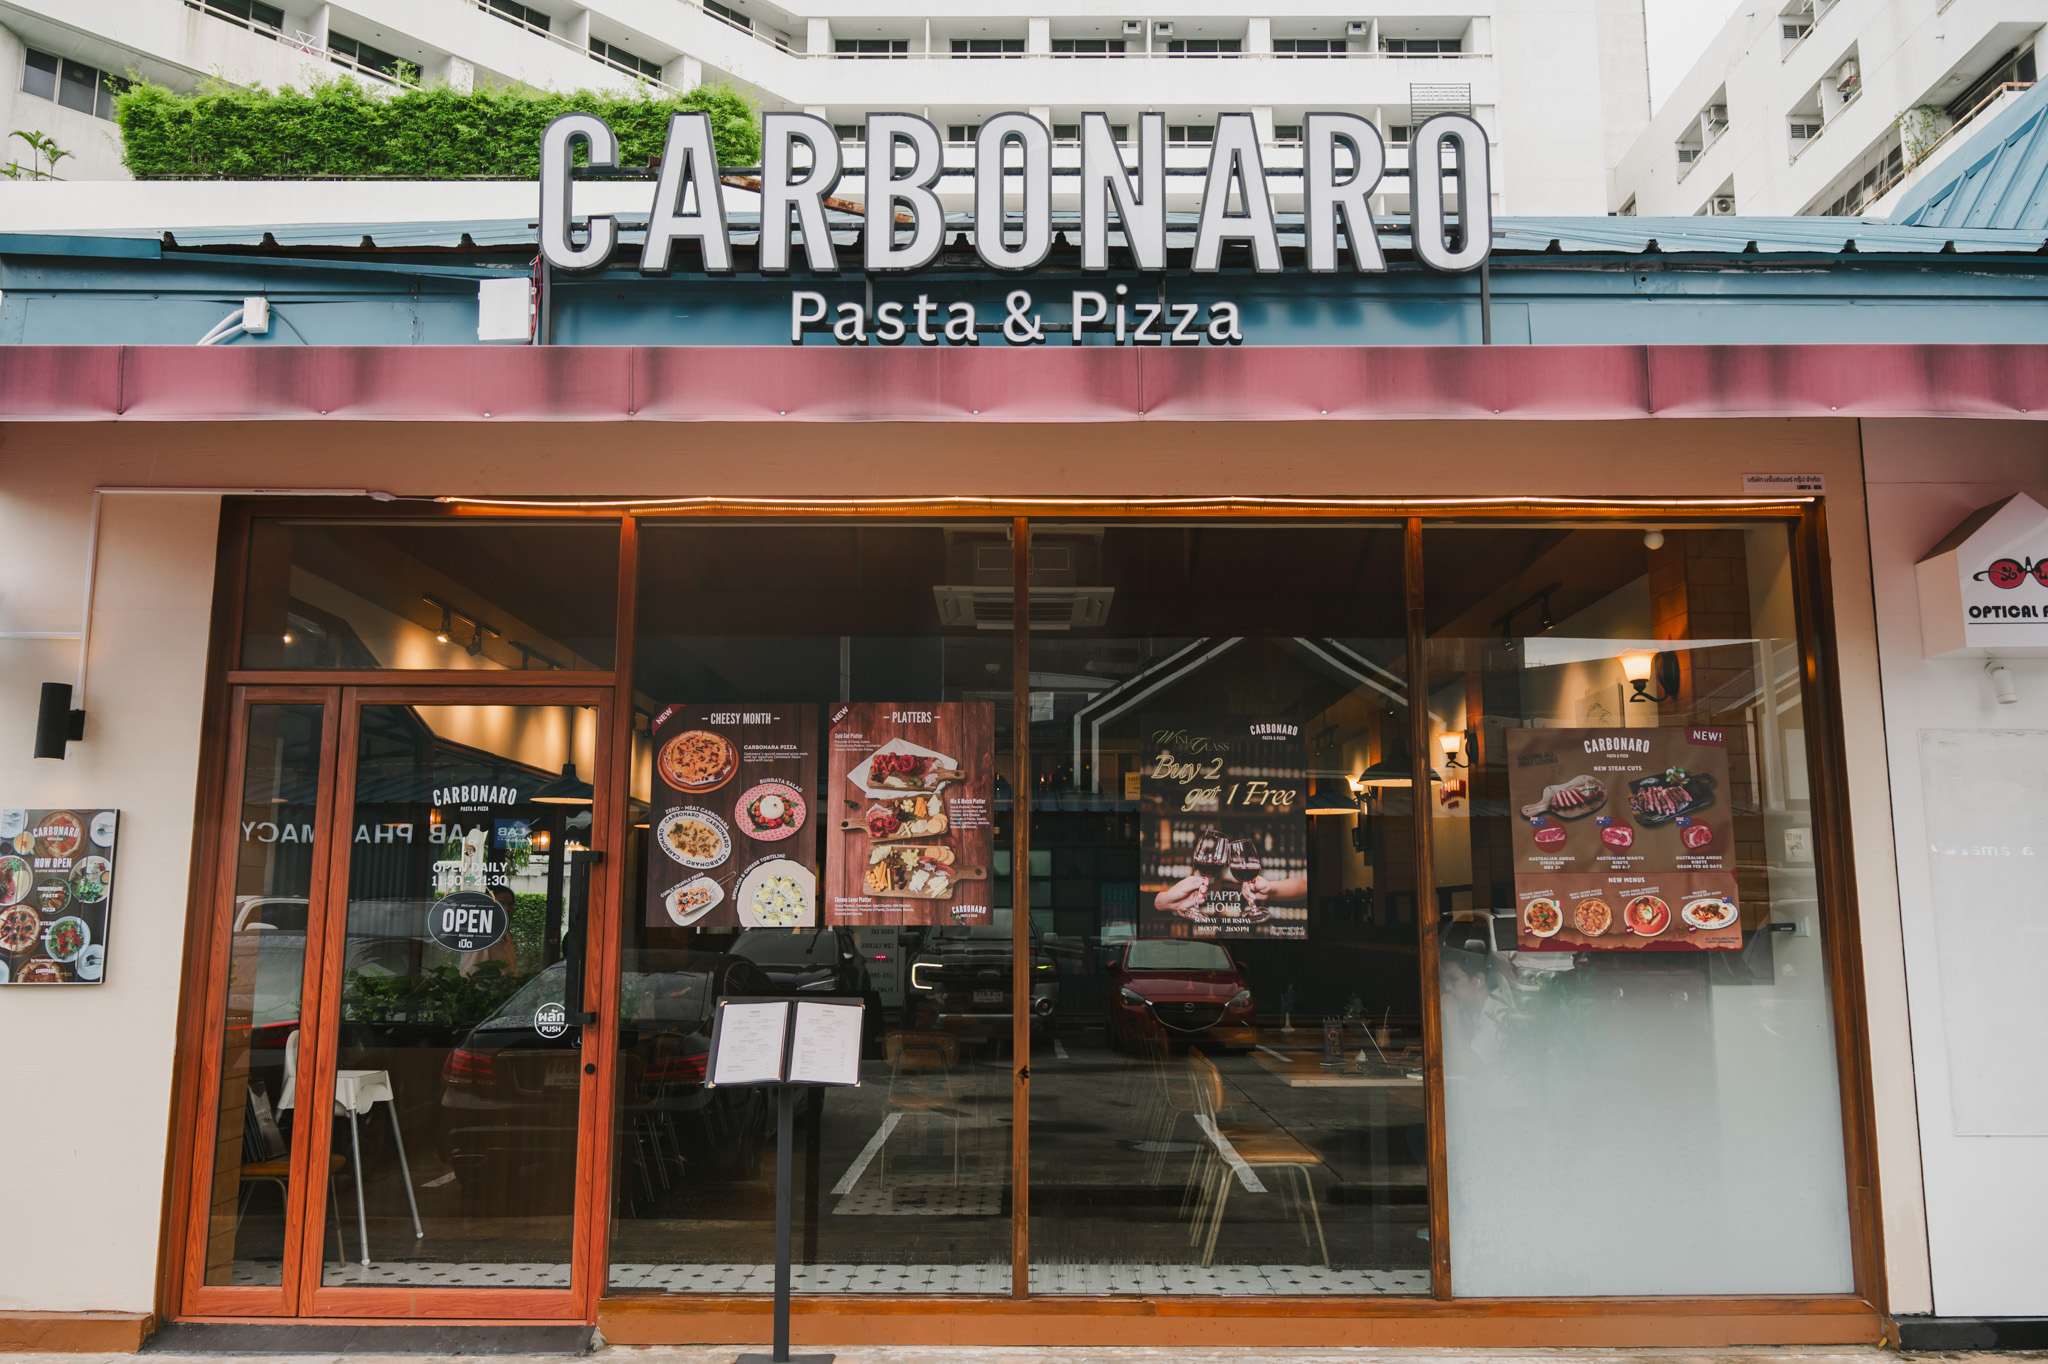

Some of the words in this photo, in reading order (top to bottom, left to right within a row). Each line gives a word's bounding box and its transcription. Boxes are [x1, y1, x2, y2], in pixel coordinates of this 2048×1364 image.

[538, 110, 1493, 276] CARBONARO
[791, 289, 979, 346] Pasta
[1000, 289, 1045, 346] &
[1071, 284, 1244, 346] Pizza
[1969, 605, 2038, 618] OPTICAL
[656, 708, 673, 725] NEW
[711, 713, 741, 724] CHEESY
[743, 713, 771, 724] MONTH
[832, 706, 849, 723] NEW
[892, 712, 932, 723] PLATTERS
[1250, 724, 1298, 736] CARBONARO
[1693, 731, 1722, 742] NEW!
[1584, 737, 1650, 753] CARBONARO
[1151, 755, 1201, 785] Buy
[1204, 758, 1223, 779] 2
[786, 781, 802, 792] SALAD
[433, 785, 517, 806] CARBONARO
[1181, 785, 1222, 812] get
[1227, 783, 1240, 804] 1
[1243, 781, 1296, 805] Free
[665, 812, 699, 823] CARBONARO
[665, 806, 680, 814] ZERO
[700, 808, 730, 830] CARBONARA
[33, 826, 79, 837] CARBONARO
[706, 818, 729, 848] CARBONARO
[659, 828, 680, 860] CARBONARO
[34, 858, 51, 868] NOW
[53, 858, 72, 868] OPEN
[433, 863, 467, 872] OPEN
[472, 862, 508, 872] DAILY
[686, 854, 726, 867] CARBONARO
[432, 876, 462, 886] 11:30
[475, 875, 507, 886] 21:30
[1206, 891, 1242, 901] HAPPY
[952, 905, 986, 914] CARBONARO
[1207, 903, 1242, 913] HOUR
[442, 908, 493, 933] OPEN
[459, 938, 472, 948] เปิด
[538, 1009, 565, 1022] ผลัก
